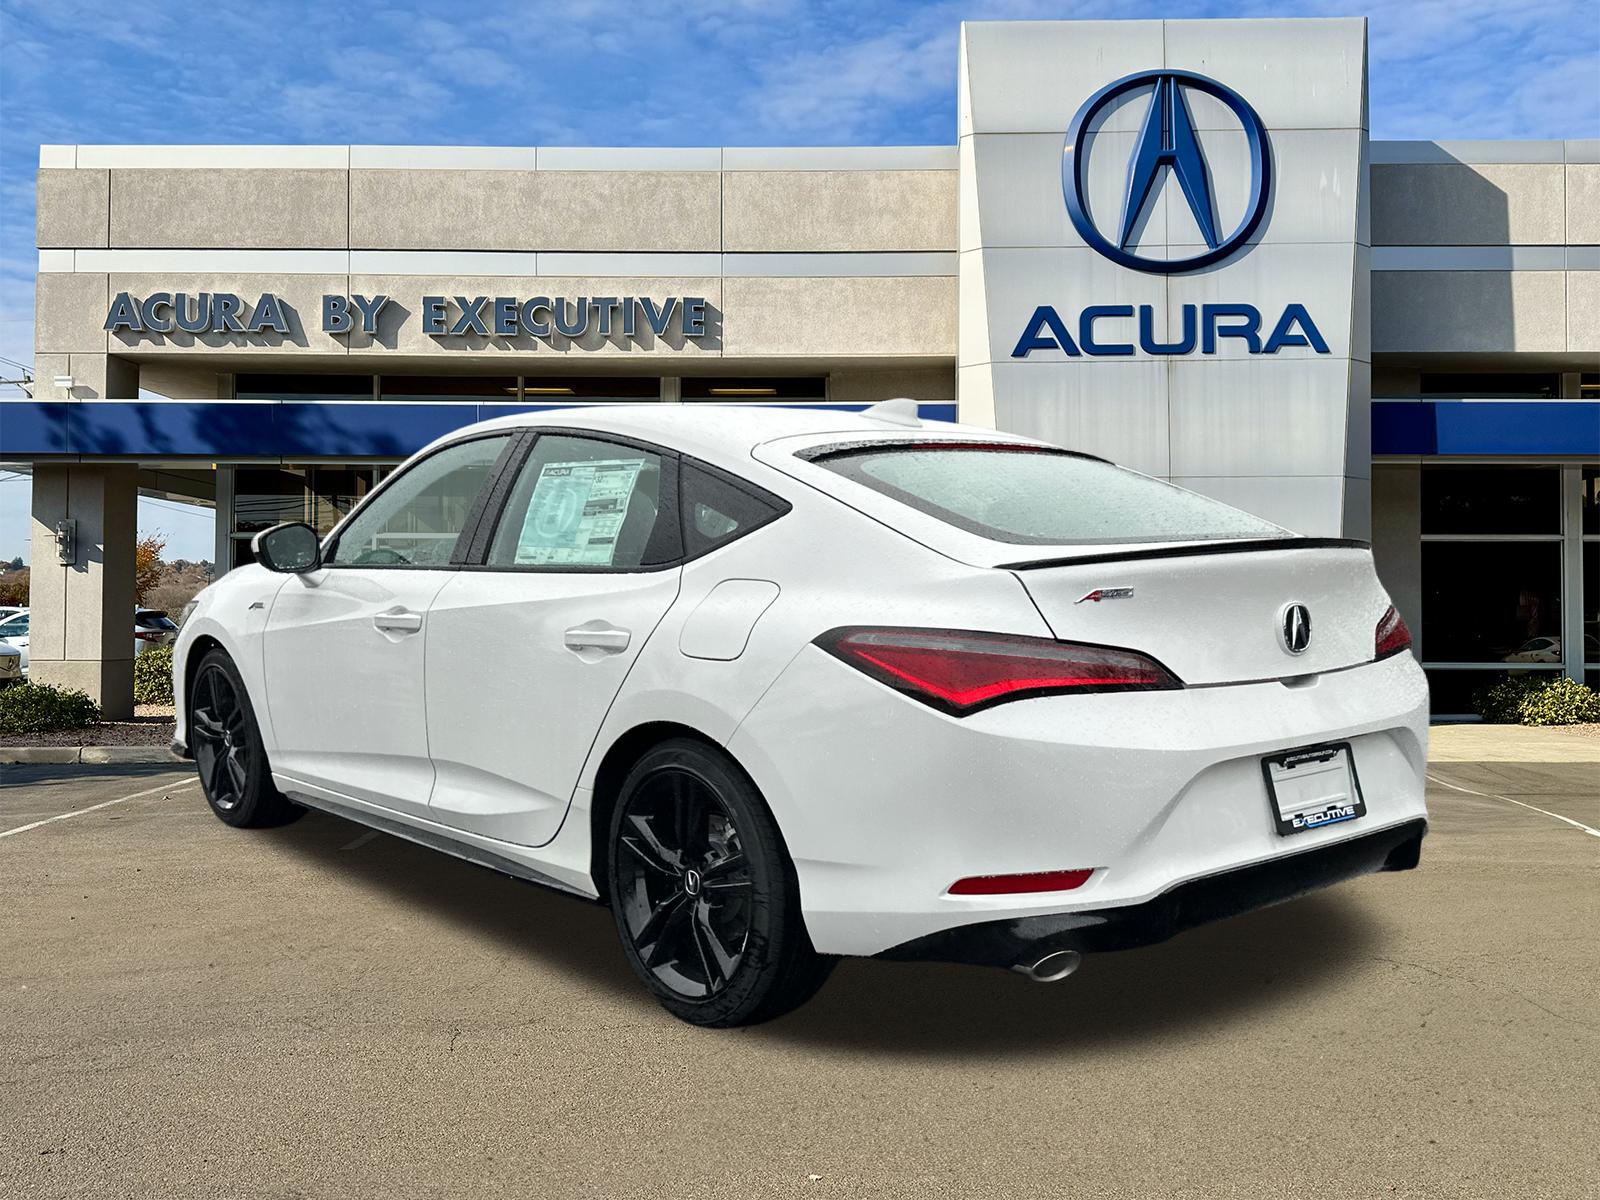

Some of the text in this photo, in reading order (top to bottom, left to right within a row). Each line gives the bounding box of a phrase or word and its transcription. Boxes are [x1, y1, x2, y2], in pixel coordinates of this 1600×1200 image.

[104, 292, 705, 336] ACURA BY EXECUTIVE
[1010, 303, 1332, 357] ACURA
[1292, 806, 1355, 828] EXECUTIVE
